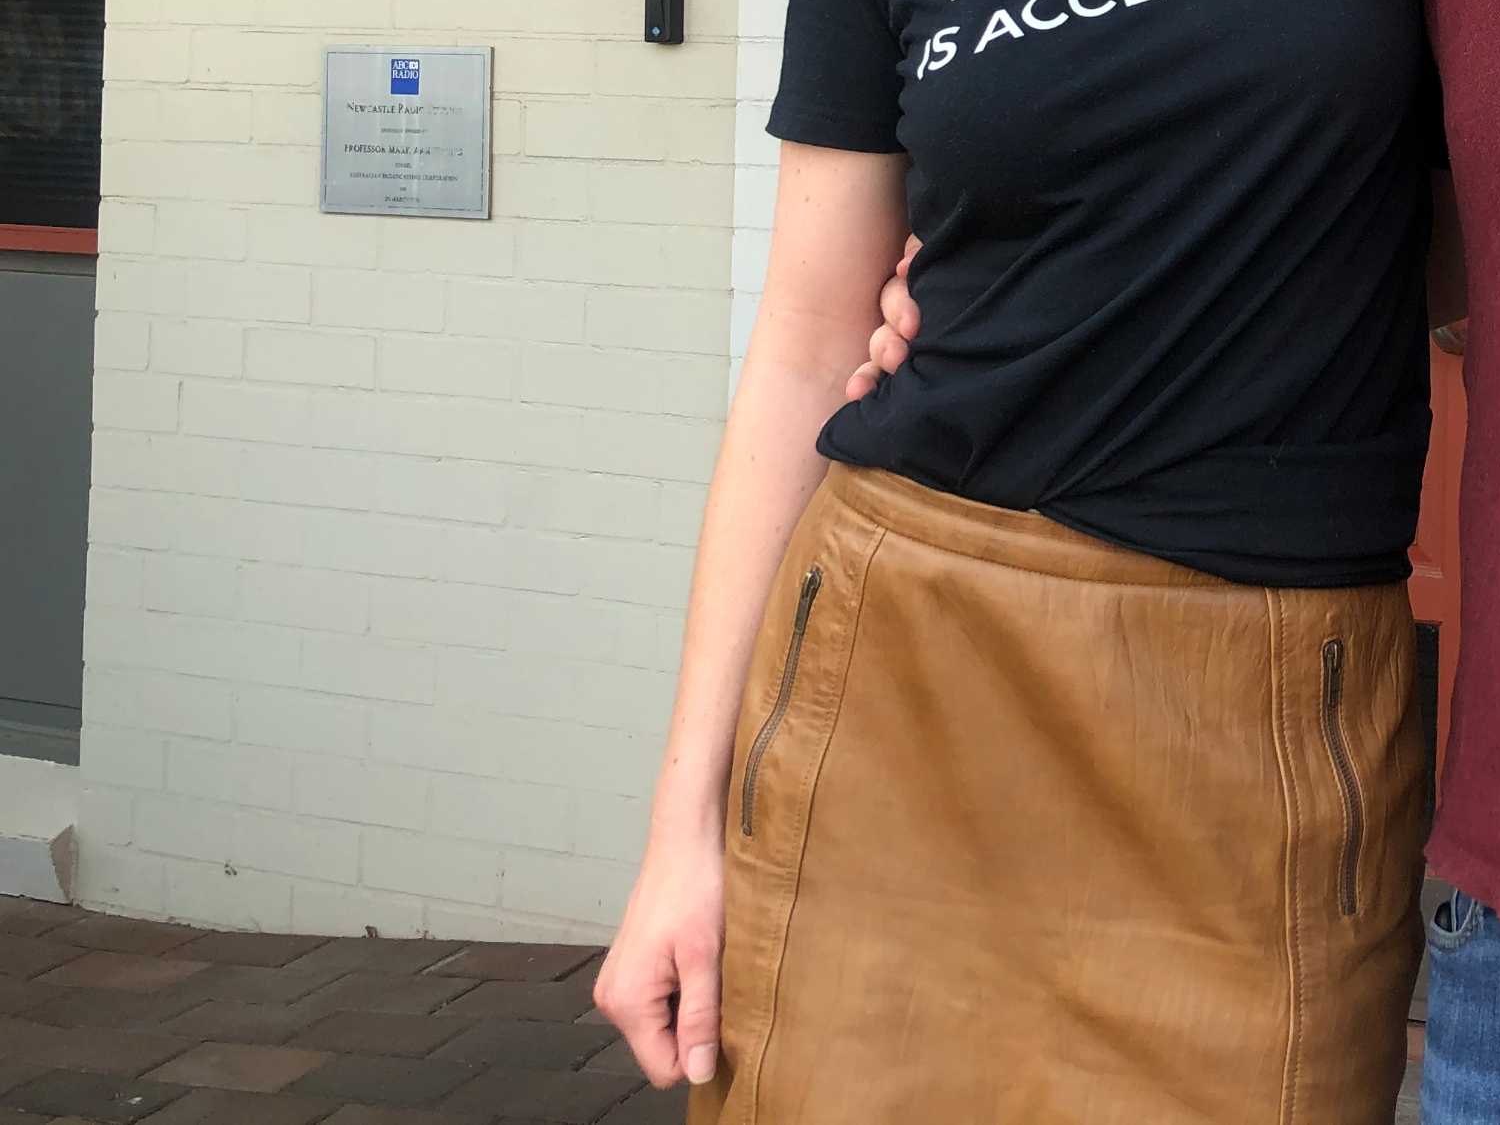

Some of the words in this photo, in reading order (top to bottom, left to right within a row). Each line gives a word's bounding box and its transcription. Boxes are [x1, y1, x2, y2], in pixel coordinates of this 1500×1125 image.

[916, 26, 961, 81] IS
[392, 60, 409, 70] ABC
[392, 69, 419, 80] RADIO
